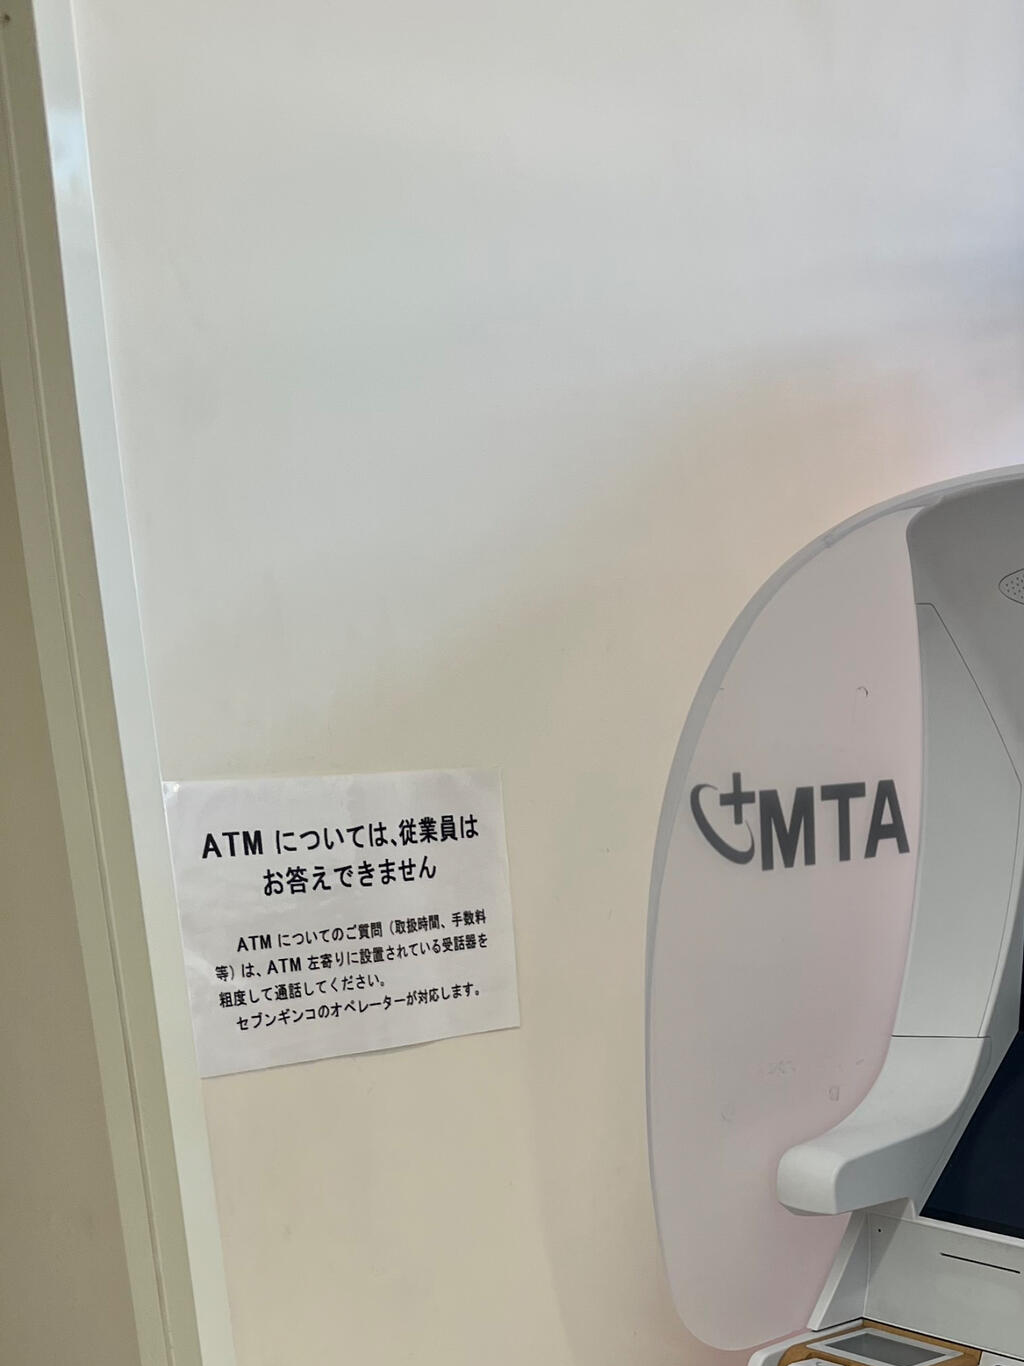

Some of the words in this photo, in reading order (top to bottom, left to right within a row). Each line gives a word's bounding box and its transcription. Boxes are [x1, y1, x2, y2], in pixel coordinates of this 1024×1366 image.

[202, 829, 264, 859] ATM
[263, 855, 437, 897] お答えできません
[237, 934, 272, 953] ATM
